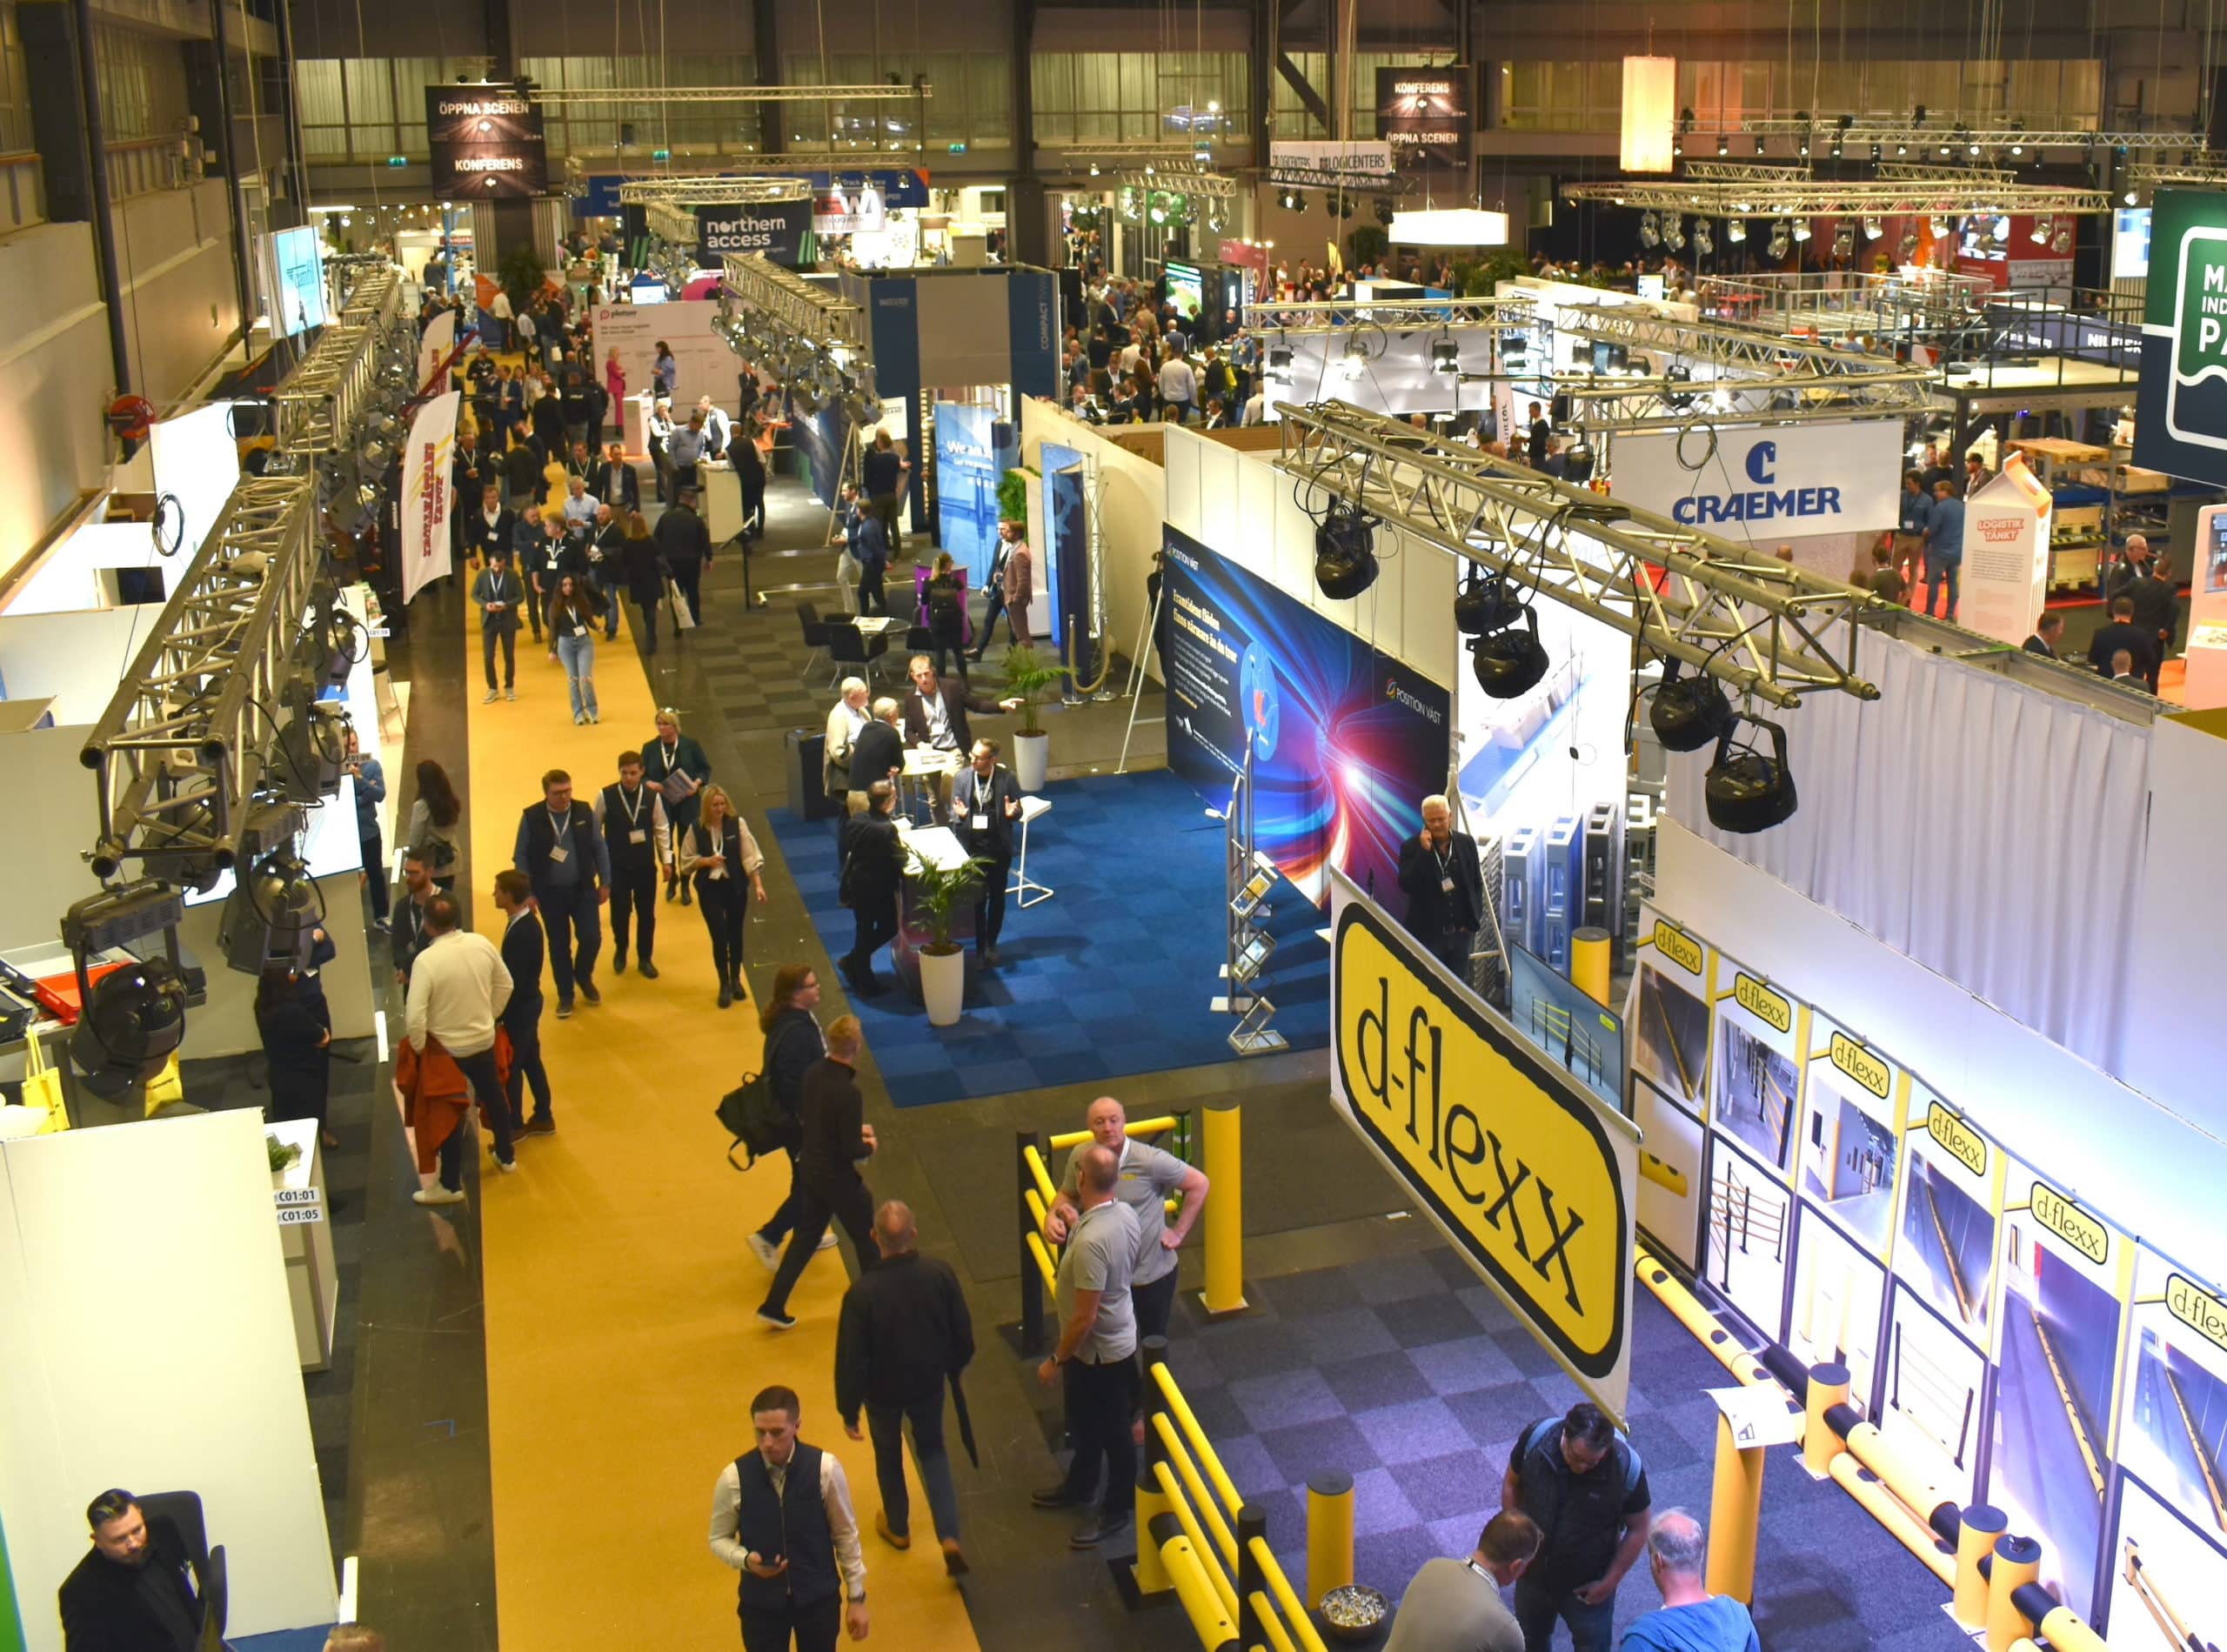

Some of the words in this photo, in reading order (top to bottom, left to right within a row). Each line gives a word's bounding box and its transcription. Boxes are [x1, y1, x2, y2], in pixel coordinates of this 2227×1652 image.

[1394, 83, 1449, 94] KONFERENS
[439, 101, 481, 115] ÖPPNA
[484, 102, 529, 115] SCENEN
[1421, 132, 1458, 144] SCENEN
[455, 158, 523, 171] KONFERENS
[1329, 154, 1386, 170] LOGICENTERS
[706, 216, 786, 234] northern
[707, 233, 772, 248] access
[2204, 264, 2227, 294] M
[1039, 302, 1049, 350] COMPACT
[946, 440, 966, 454] We
[1672, 486, 1842, 525] CRAEMER
[1977, 518, 2025, 531] LOGISTIK
[1396, 687, 1426, 716] POSITION
[1426, 705, 1441, 725] VÄST
[1658, 928, 1698, 969] d-flexx
[1740, 981, 1784, 1027] d-flexx
[1835, 1042, 1883, 1092] d-flexx
[1357, 976, 1585, 1318] d-flexx
[1933, 1114, 1980, 1169] d-flexx
[278, 1189, 315, 1202] C01:01
[282, 1209, 318, 1221] C01:05
[2037, 1195, 2099, 1256] d-flexx
[2174, 1288, 2227, 1341] d-flex
